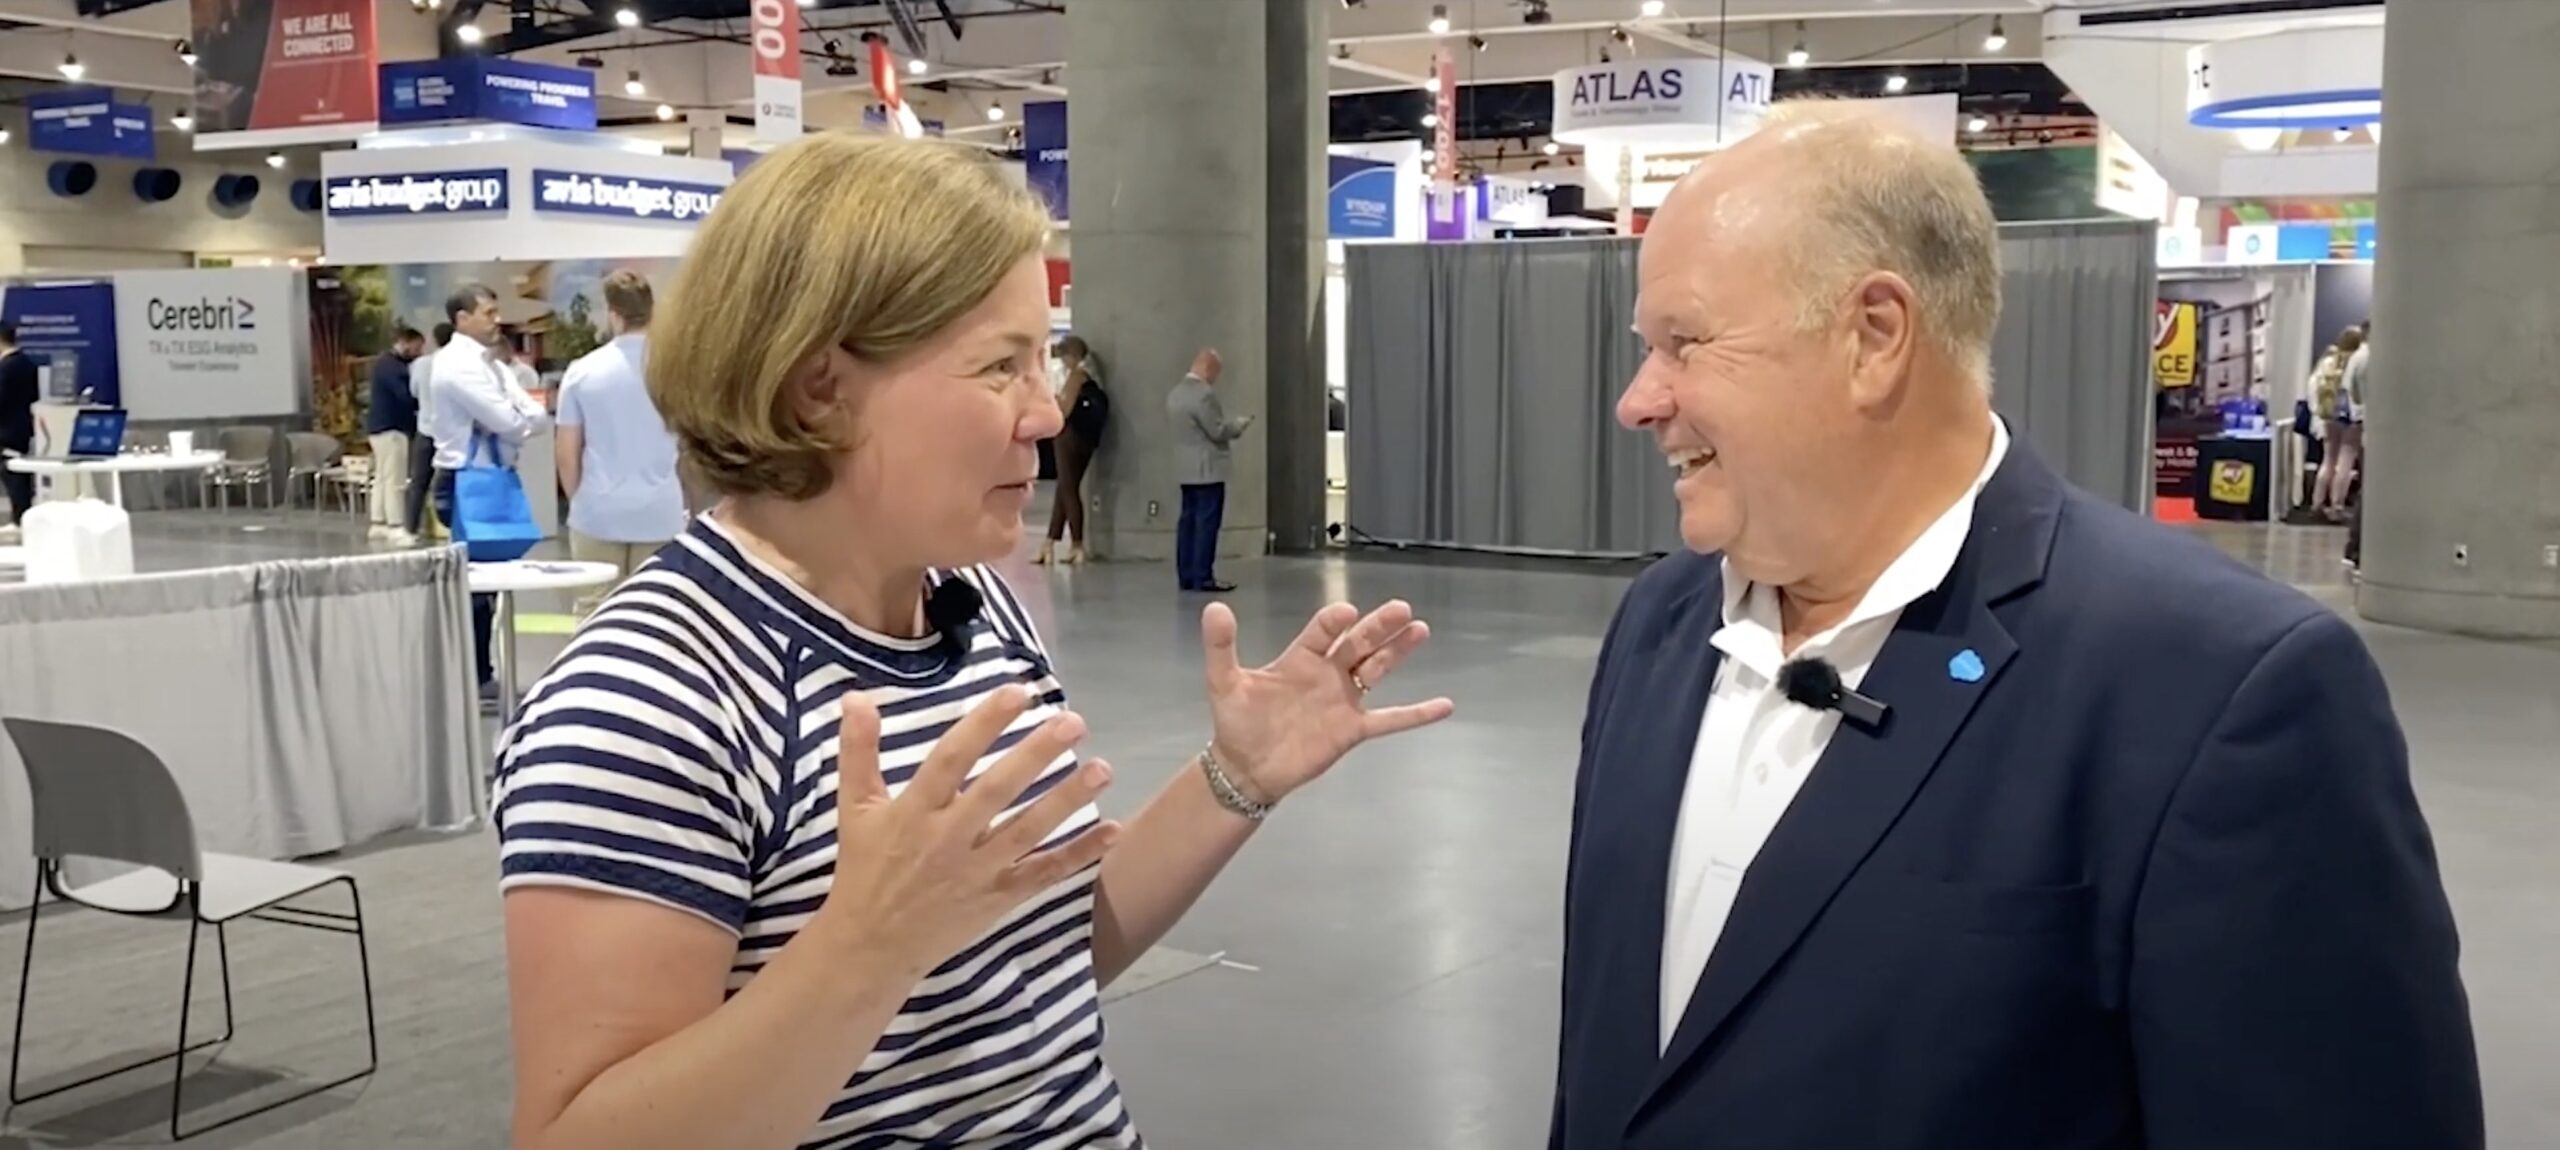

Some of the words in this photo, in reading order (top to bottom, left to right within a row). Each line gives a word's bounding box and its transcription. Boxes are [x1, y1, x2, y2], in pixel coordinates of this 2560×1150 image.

[283, 17, 302, 35] WE
[304, 15, 328, 34] ARE
[330, 12, 352, 32] ALL
[283, 34, 354, 57] CONNECTED
[485, 74, 538, 92] POWERING
[539, 81, 590, 98] PROGRESS
[1571, 68, 1682, 106] ATLAS
[531, 92, 569, 108] TRAVEL
[329, 178, 371, 209] avis
[370, 176, 444, 211] budget
[445, 178, 500, 210] group
[542, 173, 592, 204] avis
[592, 176, 672, 216] budget
